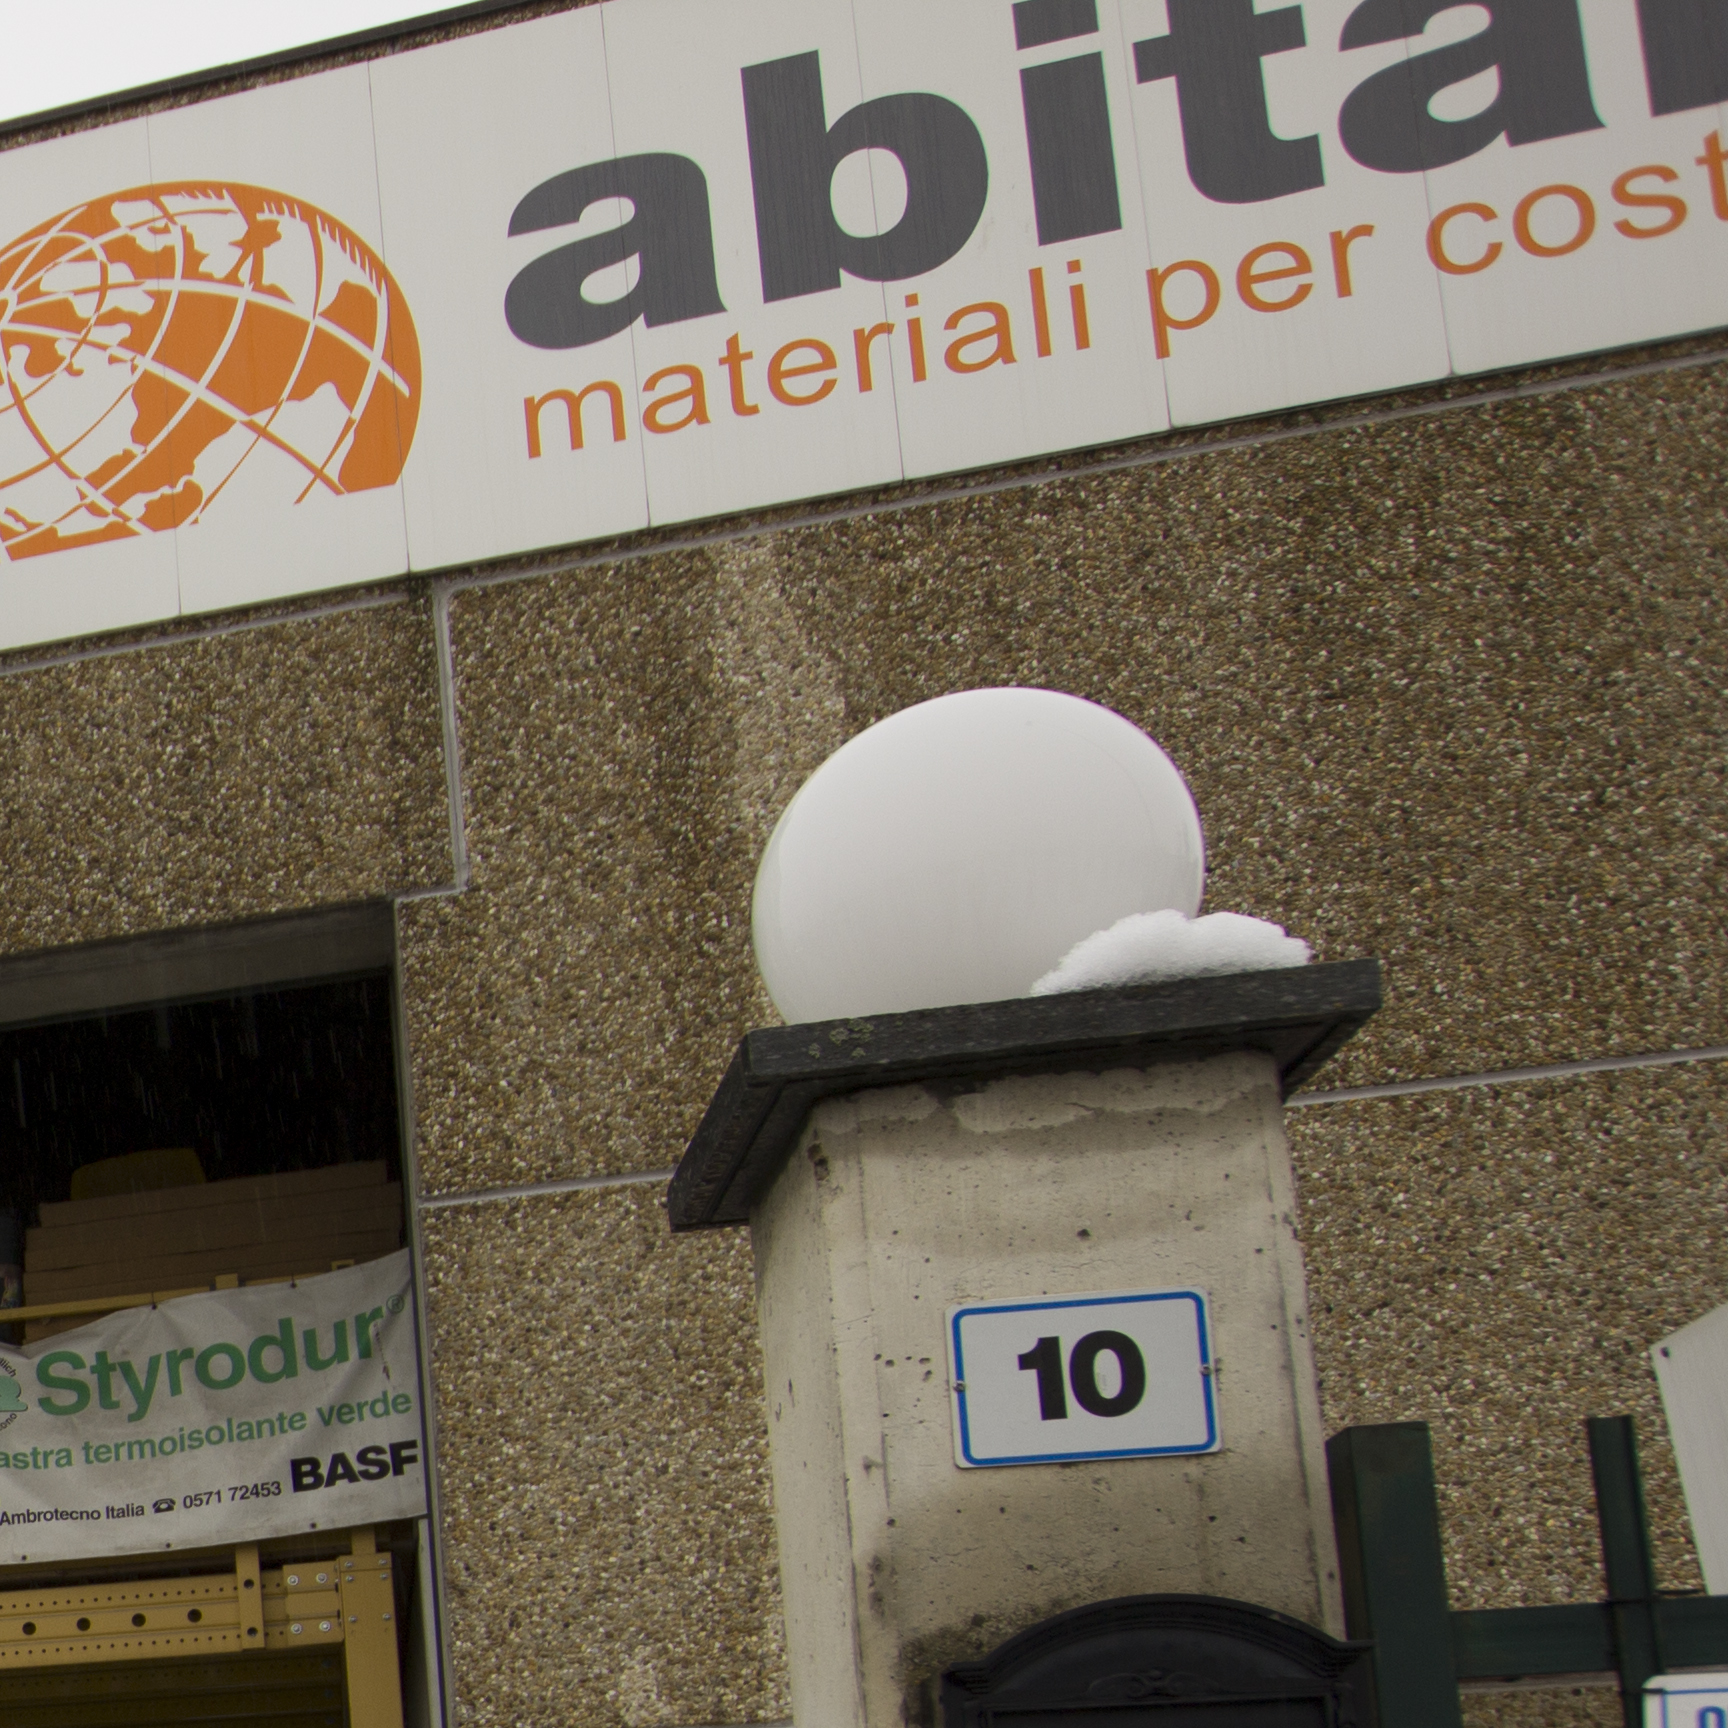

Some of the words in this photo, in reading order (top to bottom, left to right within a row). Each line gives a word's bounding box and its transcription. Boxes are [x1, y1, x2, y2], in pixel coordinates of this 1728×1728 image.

[523, 260, 1093, 461] materiali
[1145, 220, 1375, 361] per
[1017, 1329, 1147, 1421] 10
[82, 1408, 307, 1465] termoisolante
[318, 1388, 412, 1429] verde
[0, 1505, 100, 1528] Ambrotecno
[105, 1502, 146, 1521] Italia
[182, 1491, 223, 1511] 0571
[228, 1481, 282, 1502] 72453
[290, 1439, 419, 1494] BASF
